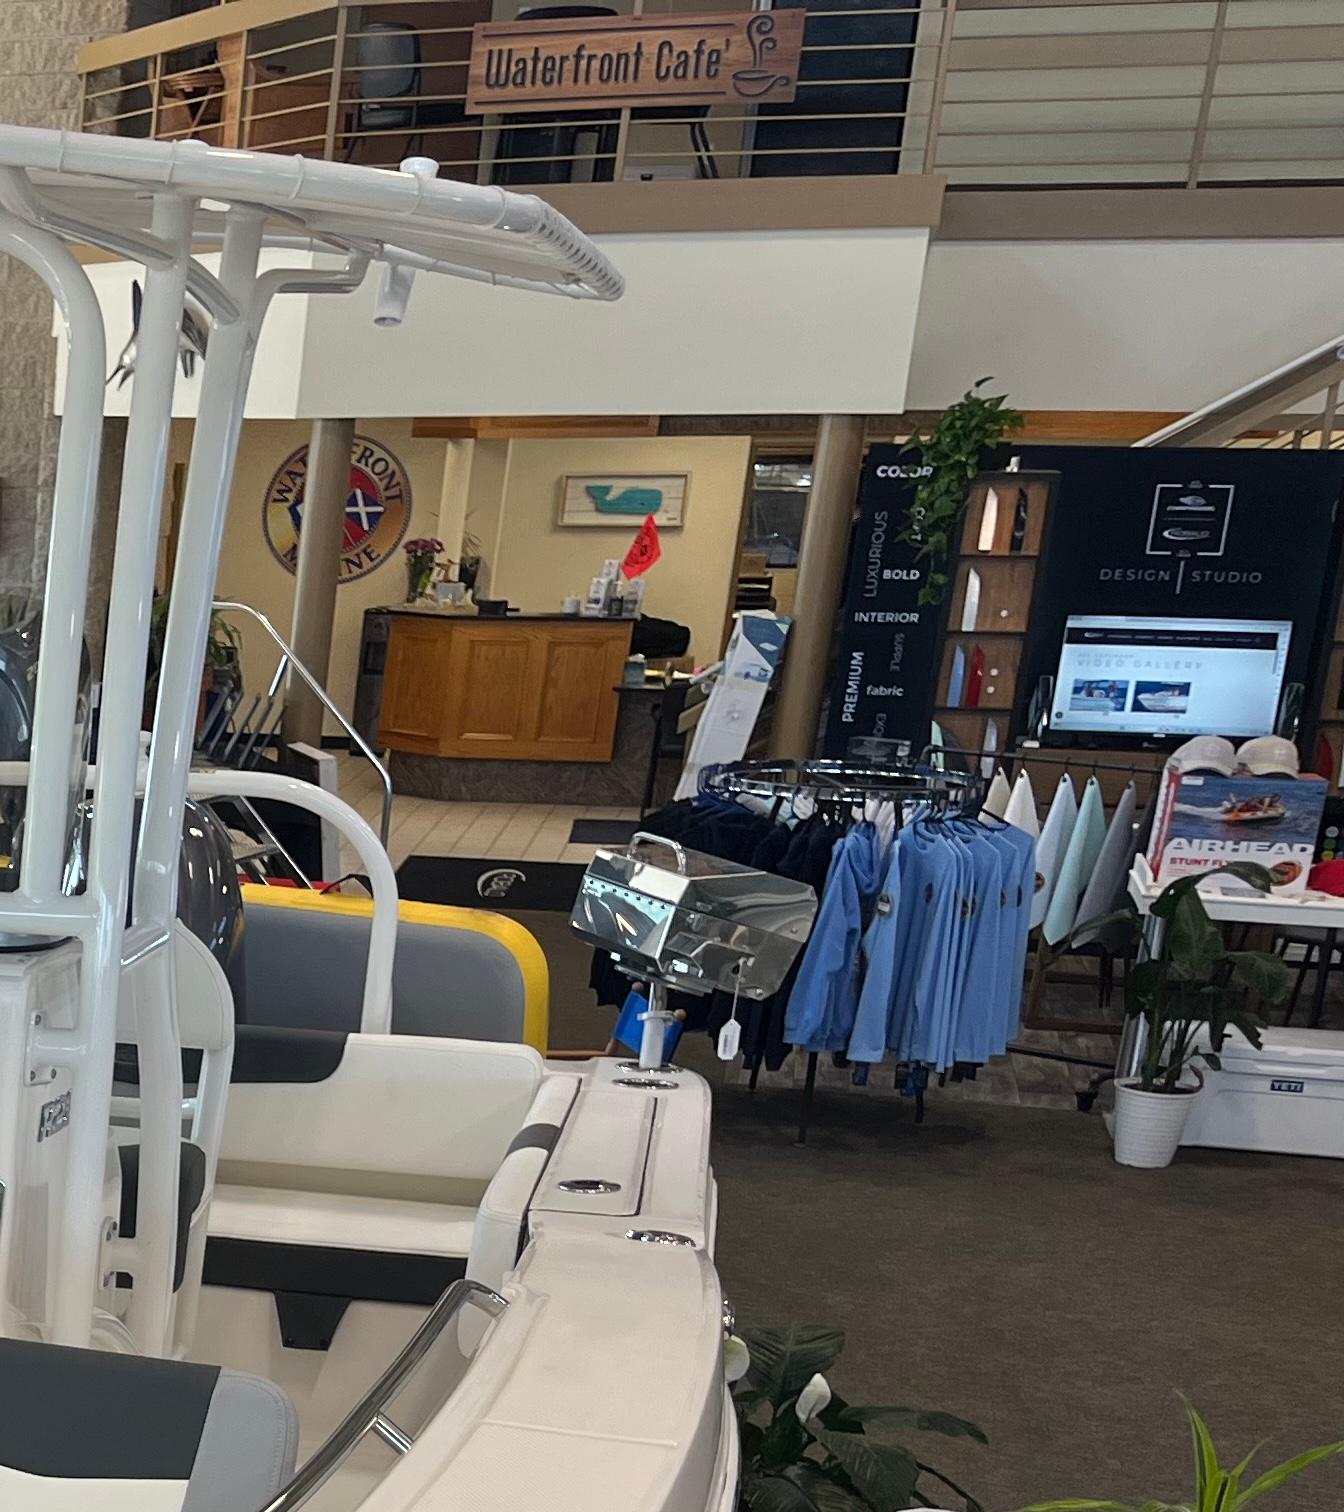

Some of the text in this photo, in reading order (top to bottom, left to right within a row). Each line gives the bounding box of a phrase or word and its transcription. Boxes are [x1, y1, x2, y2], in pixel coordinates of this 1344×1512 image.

[485, 41, 646, 90] Waterfront
[864, 511, 889, 598] LUXURIOUS
[883, 569, 920, 581] BOLD
[1099, 568, 1263, 584] DESIGN STUDIO
[854, 612, 920, 624] INTERIOR
[842, 651, 865, 722] PREMIUM
[866, 685, 904, 697] fabric
[1166, 837, 1314, 856] AIRHEAD
[1169, 857, 1211, 866] STUNT
[1273, 1082, 1302, 1091] YETI
